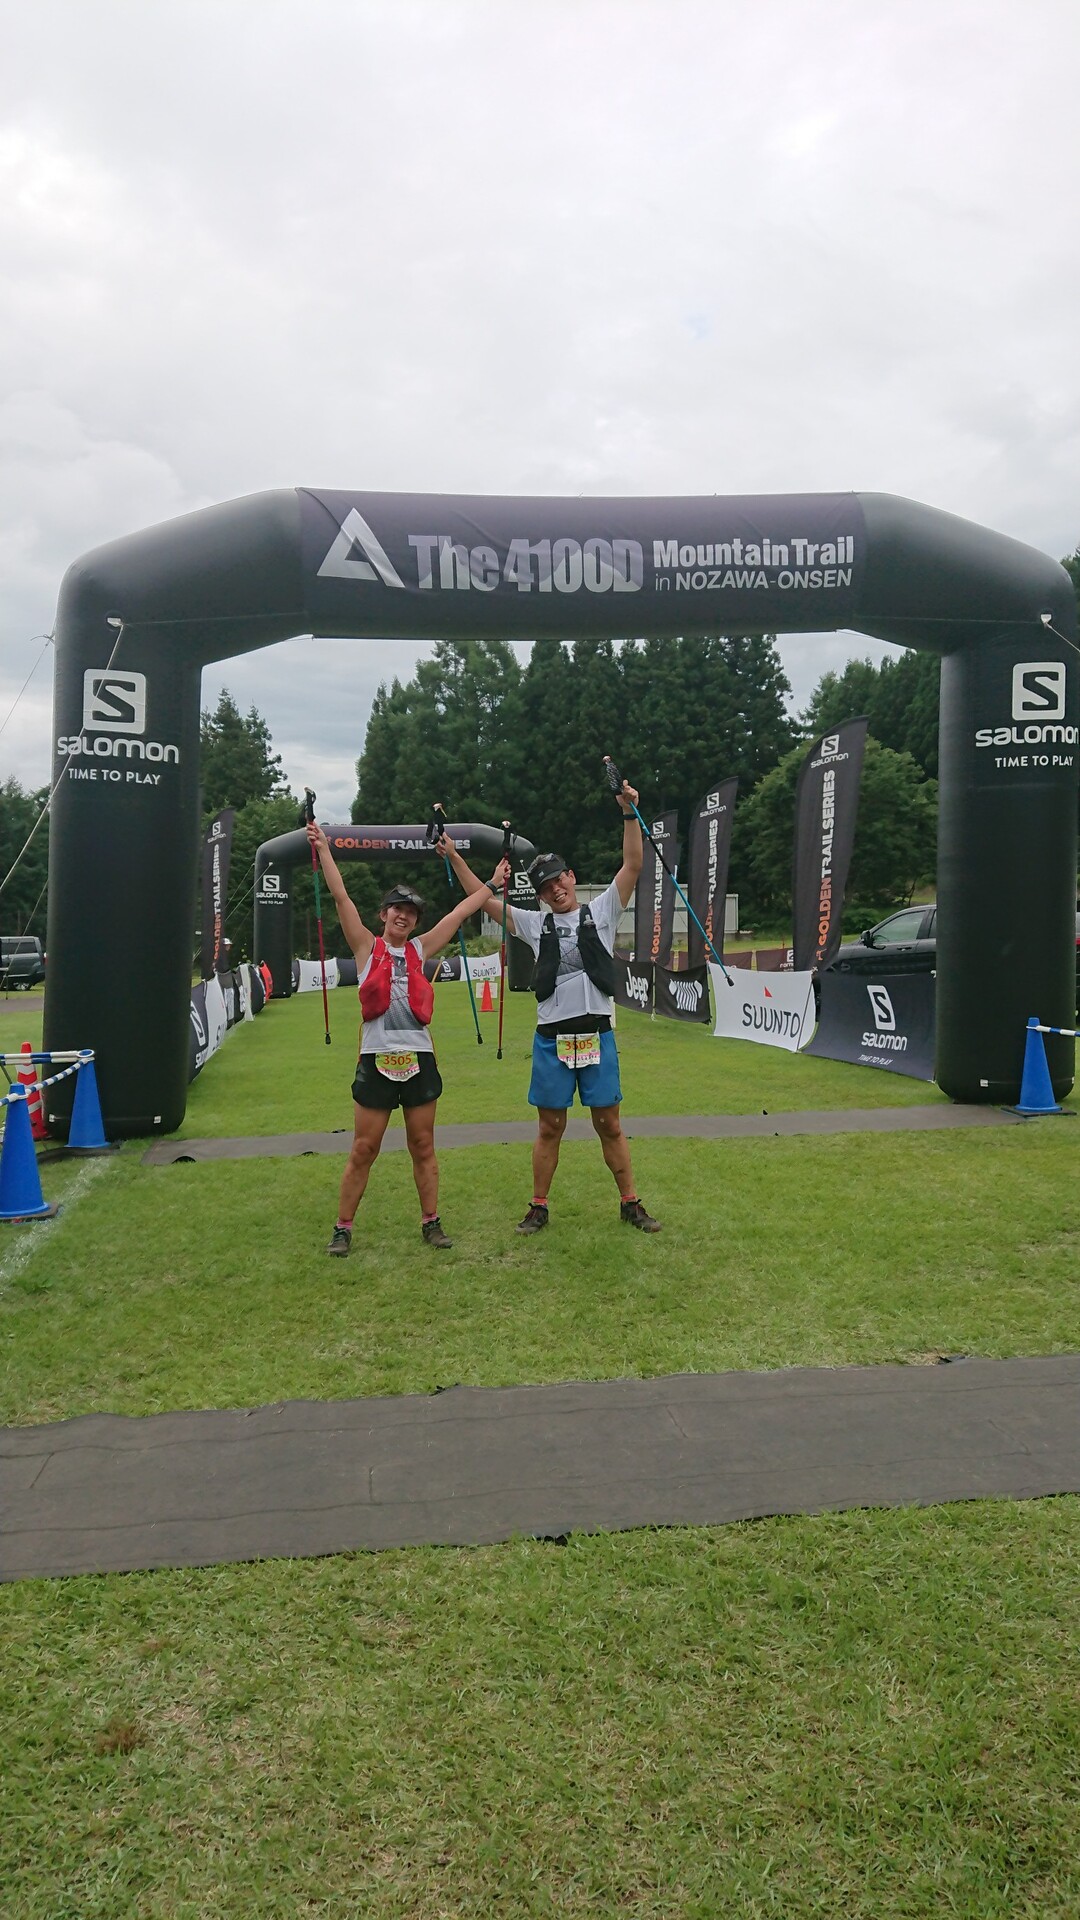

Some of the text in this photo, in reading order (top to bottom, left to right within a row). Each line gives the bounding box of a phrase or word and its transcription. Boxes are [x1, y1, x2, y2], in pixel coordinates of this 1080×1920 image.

[408, 534, 644, 593] The 4100D
[652, 535, 854, 568] Mountain Trail
[655, 568, 853, 591] in NOZAWA-ONSEN
[994, 755, 1074, 768] TIME TO PLAY
[68, 767, 161, 786] TIME TO PLAY
[818, 769, 835, 946] GOLDENTRAILSERIES
[626, 966, 649, 1008] Jeep
[742, 1002, 801, 1039] SUUNTO
[383, 1054, 412, 1065] 3505
[564, 1040, 593, 1051] 3505
